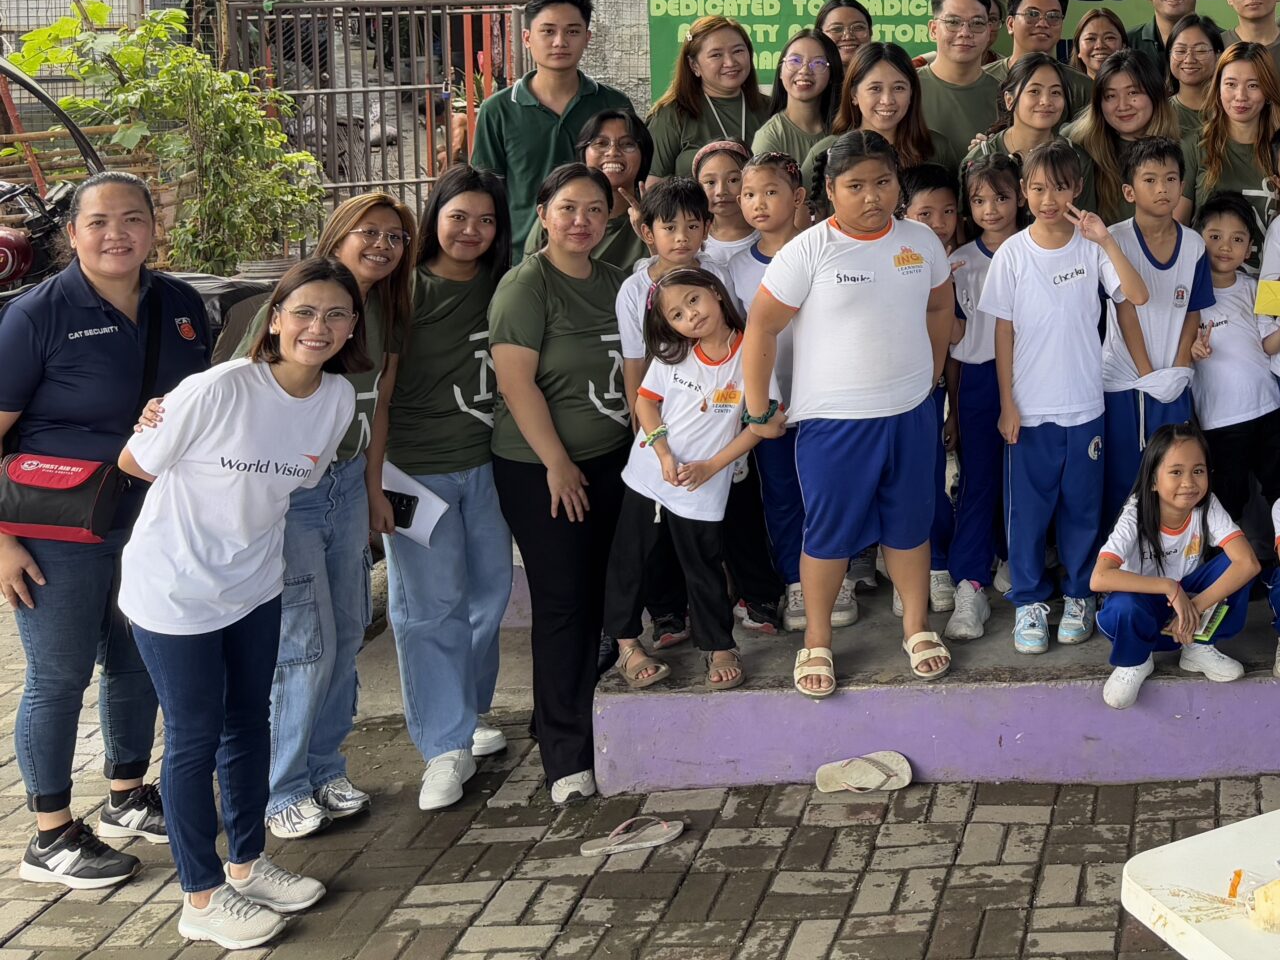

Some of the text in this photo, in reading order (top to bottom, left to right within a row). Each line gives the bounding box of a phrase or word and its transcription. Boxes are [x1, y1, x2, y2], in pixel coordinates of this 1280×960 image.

[897, 253, 920, 265] ING
[68, 326, 119, 340] CAT SECURITY
[717, 391, 736, 401] ING
[220, 457, 312, 478] World Vision
